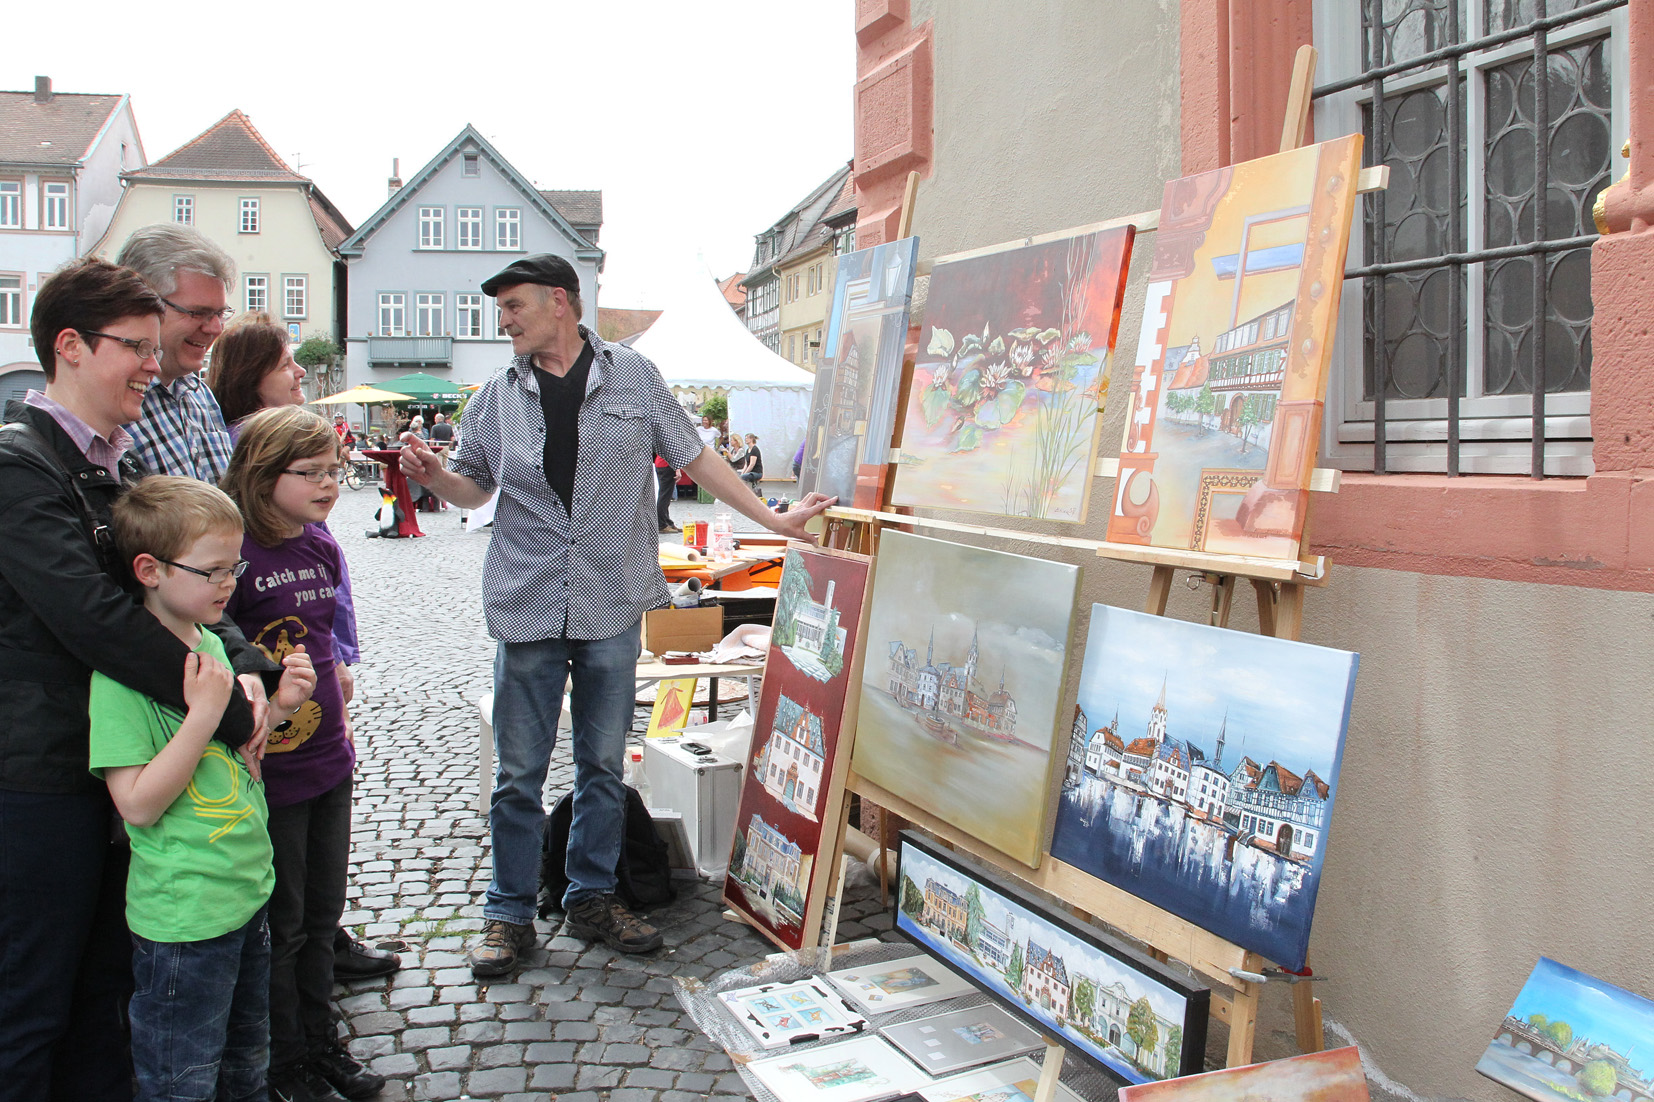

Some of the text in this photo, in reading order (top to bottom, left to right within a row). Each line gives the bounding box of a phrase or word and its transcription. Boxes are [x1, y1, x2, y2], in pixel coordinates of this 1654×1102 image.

[255, 568, 296, 592] Catch
[298, 568, 317, 581] me
[295, 589, 317, 607] you
